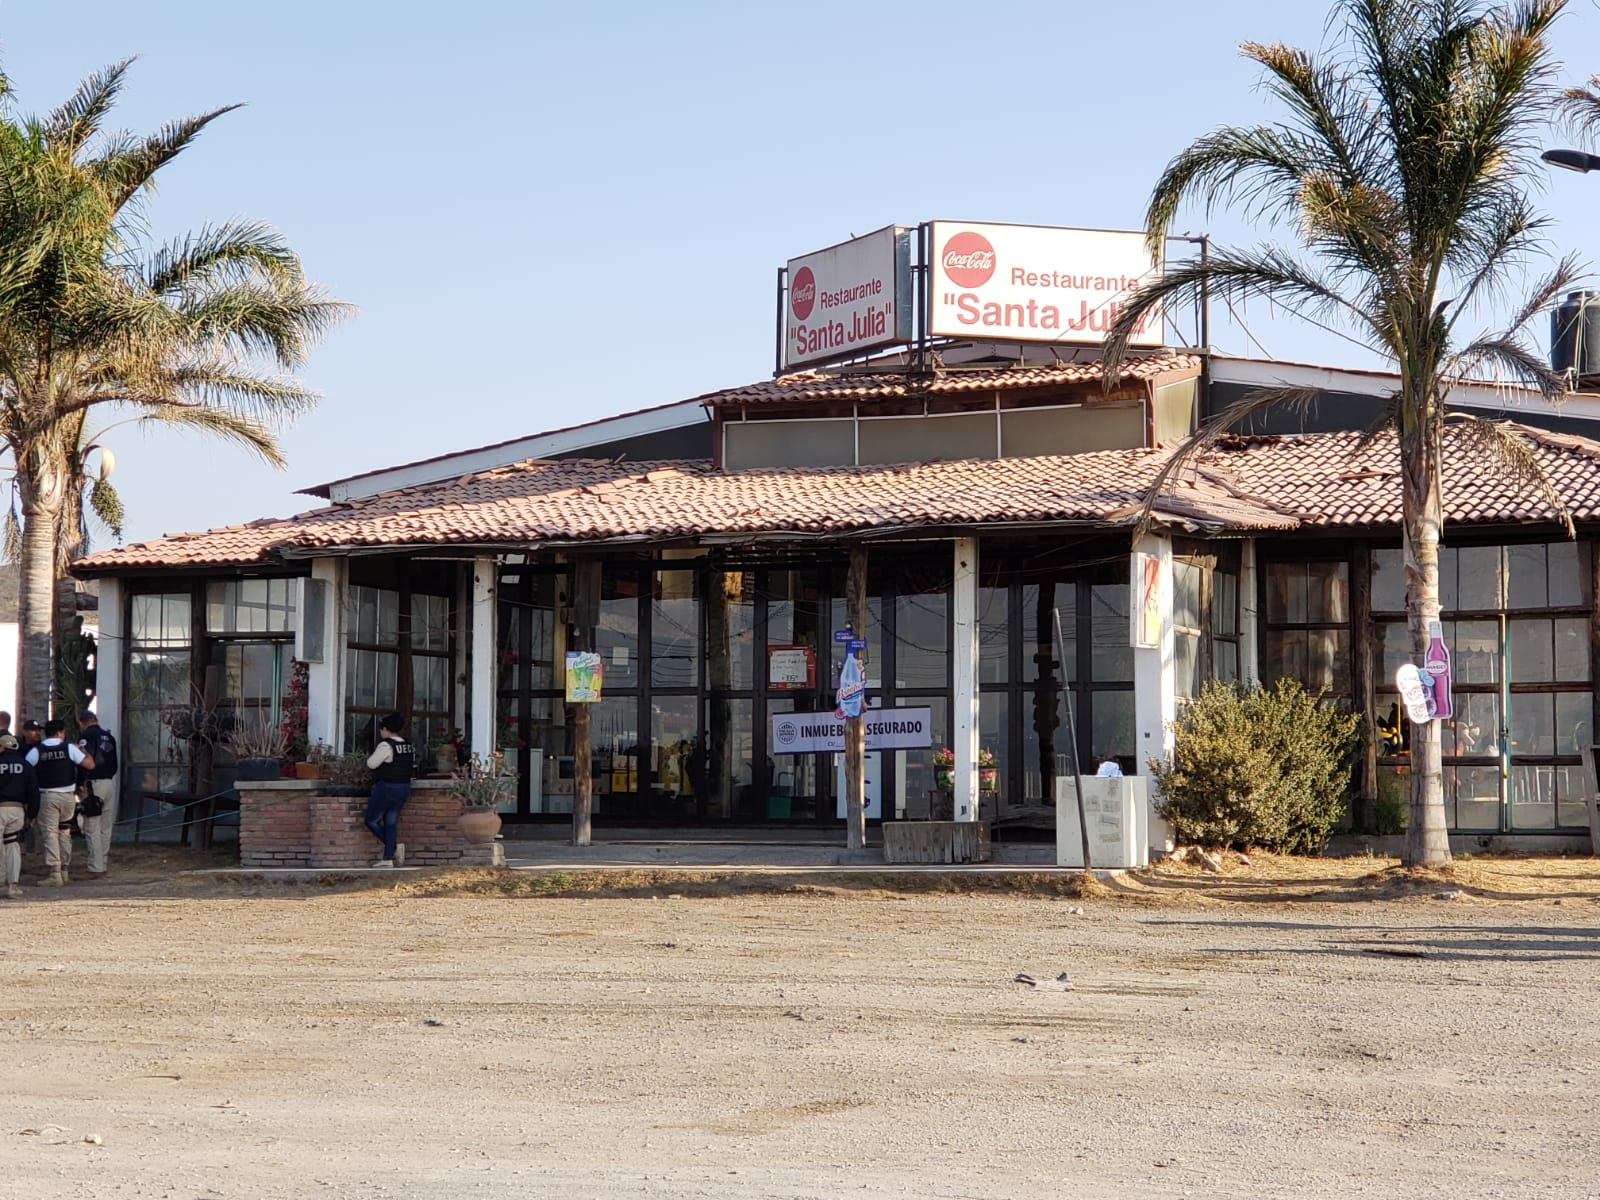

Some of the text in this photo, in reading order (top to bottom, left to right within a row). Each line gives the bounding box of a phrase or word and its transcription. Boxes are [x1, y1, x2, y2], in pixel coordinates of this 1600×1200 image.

[1011, 266, 1139, 292] Restaurante
[820, 278, 882, 310] Restaurante
[944, 292, 1060, 330] "Santa
[791, 301, 892, 355] "Santa Julia"
[800, 724, 844, 738] INMUEB
[864, 720, 922, 736] SEGURADO
[0, 763, 23, 774] PID
